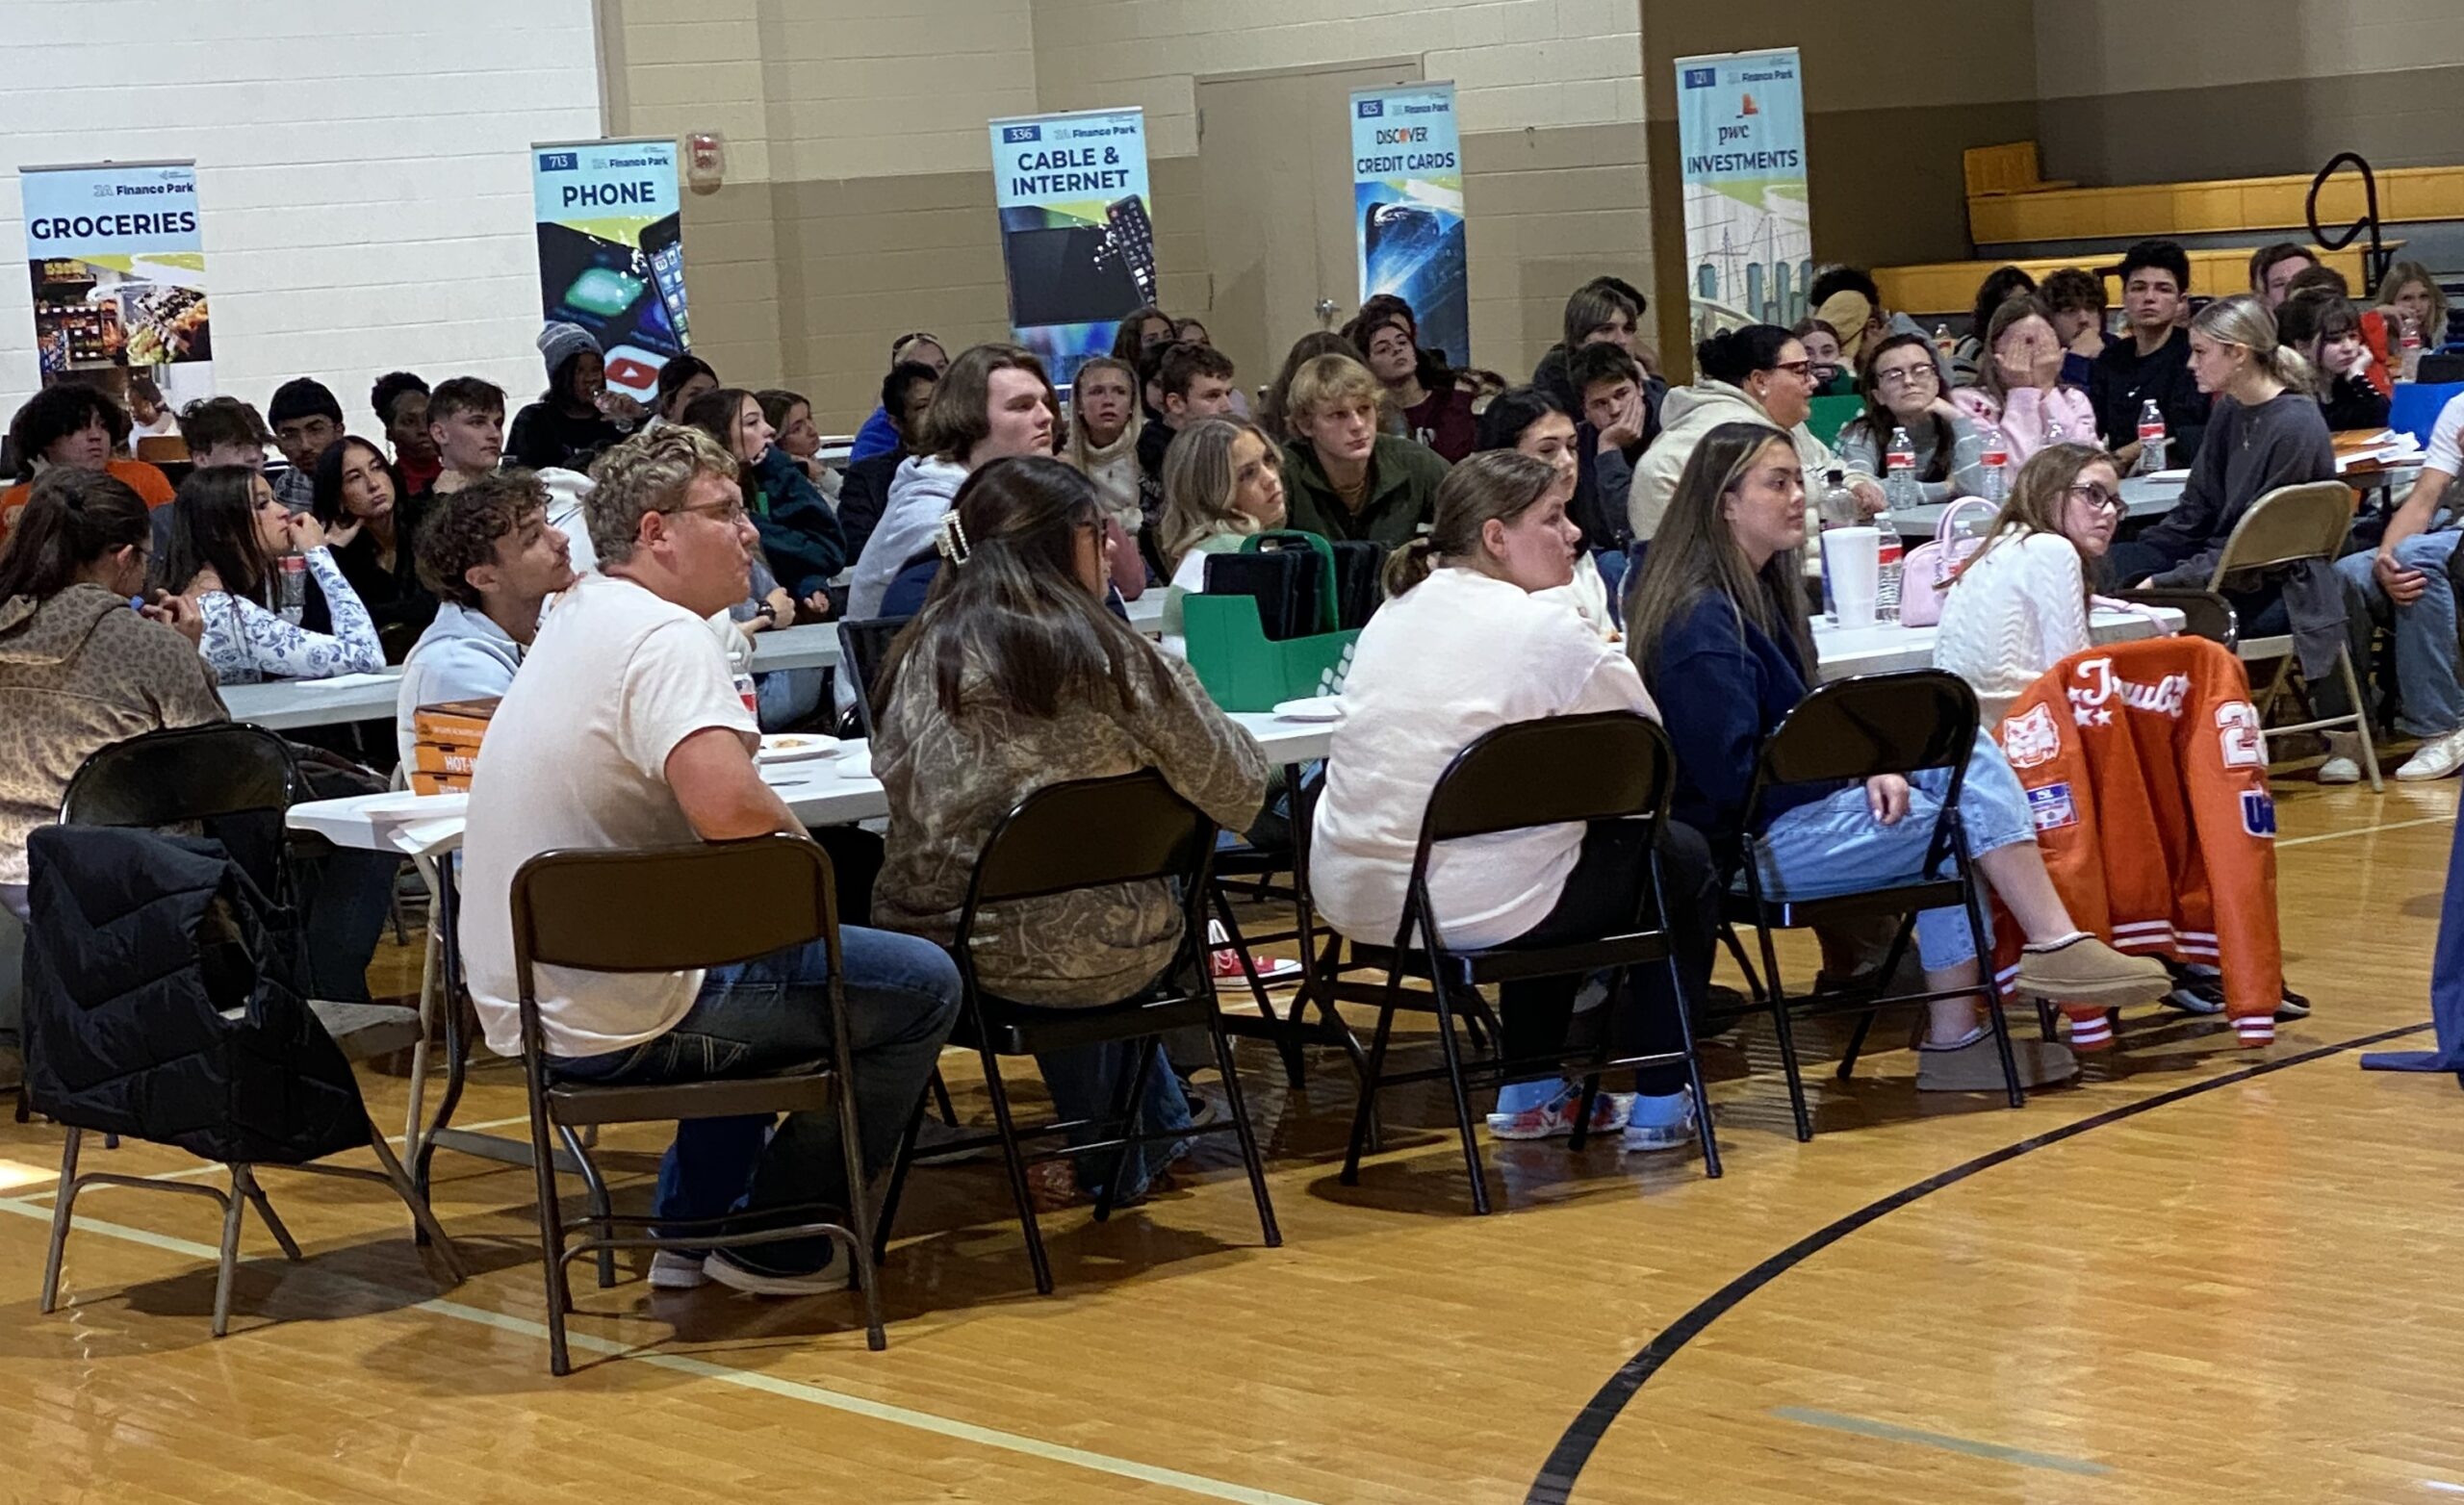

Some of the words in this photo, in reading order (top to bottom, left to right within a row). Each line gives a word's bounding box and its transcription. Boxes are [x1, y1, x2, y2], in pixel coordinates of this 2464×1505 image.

[1010, 127, 1034, 141] 336
[1072, 128, 1112, 139] Finance
[1113, 125, 1137, 136] Park
[1375, 126, 1428, 145] DISCOVER
[1718, 125, 1750, 145] pwc
[549, 155, 569, 168] 713
[609, 159, 647, 168] Finance
[648, 156, 669, 166] Park
[1017, 147, 1097, 171] CABLE
[1103, 145, 1120, 166] &
[1357, 155, 1404, 174] CREDIT
[1406, 152, 1455, 170] CARDS
[1687, 149, 1799, 174] INVESTMENTS
[116, 185, 166, 196] Finance
[166, 182, 194, 193] Park
[1013, 169, 1130, 196] INTERNET
[562, 181, 656, 208] PHONE
[31, 211, 197, 240] GROCERIES
